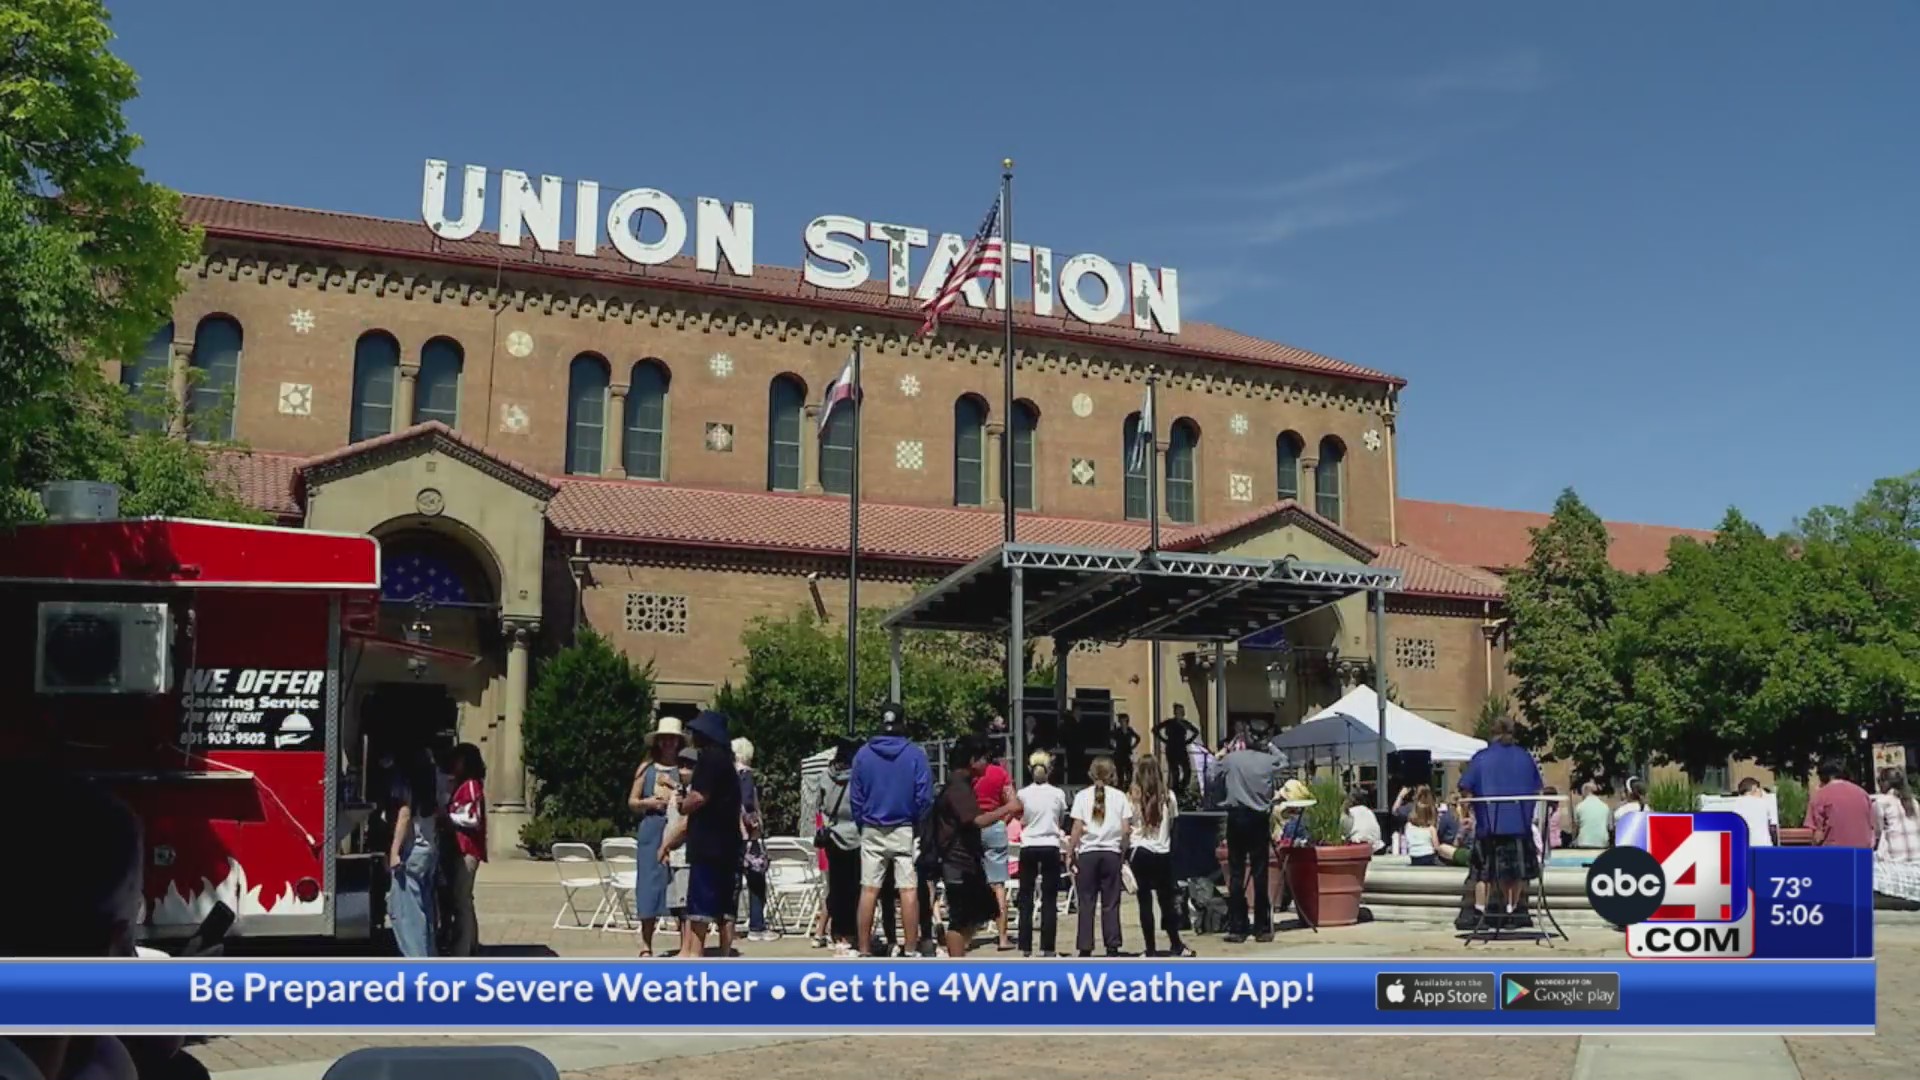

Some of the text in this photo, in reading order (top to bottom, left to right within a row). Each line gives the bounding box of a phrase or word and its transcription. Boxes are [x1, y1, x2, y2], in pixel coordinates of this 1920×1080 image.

[421, 158, 1180, 334] UNION STATION
[182, 669, 325, 694] WE OFFER
[181, 695, 320, 710] Catering Service
[206, 711, 229, 723] ANY
[230, 711, 264, 723] EVENT
[180, 732, 267, 745] 801-903-9502
